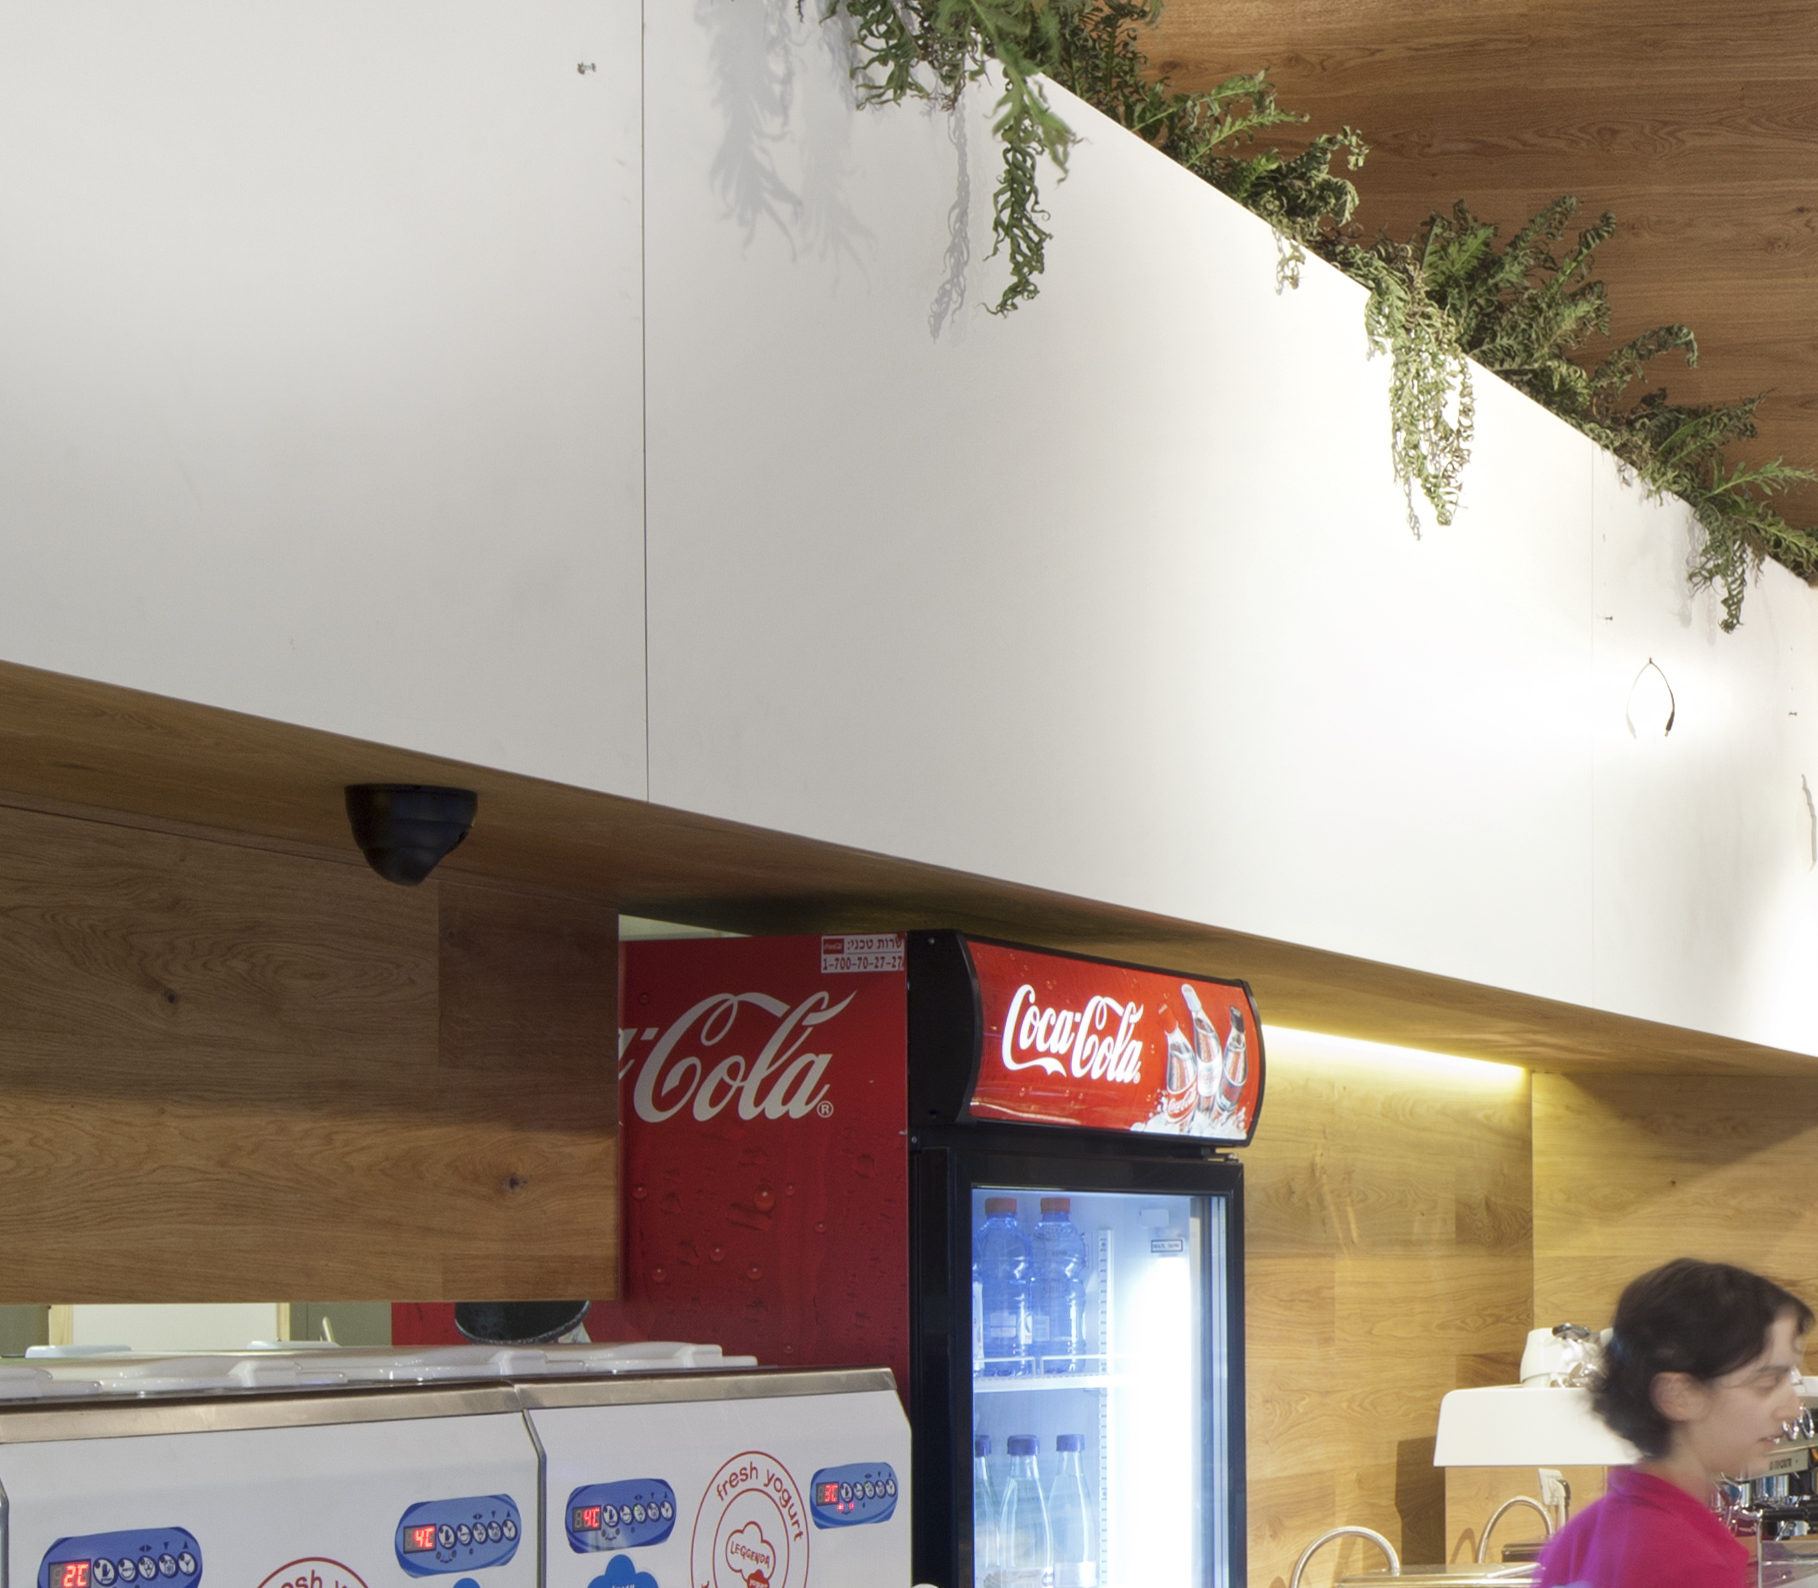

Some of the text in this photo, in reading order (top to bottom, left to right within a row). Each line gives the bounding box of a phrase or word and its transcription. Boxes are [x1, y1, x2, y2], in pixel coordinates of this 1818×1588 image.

[1002, 984, 1144, 1084] Coca-Cola
[716, 1461, 804, 1541] fresh yogurt
[730, 1541, 770, 1569] LEGGENDA
